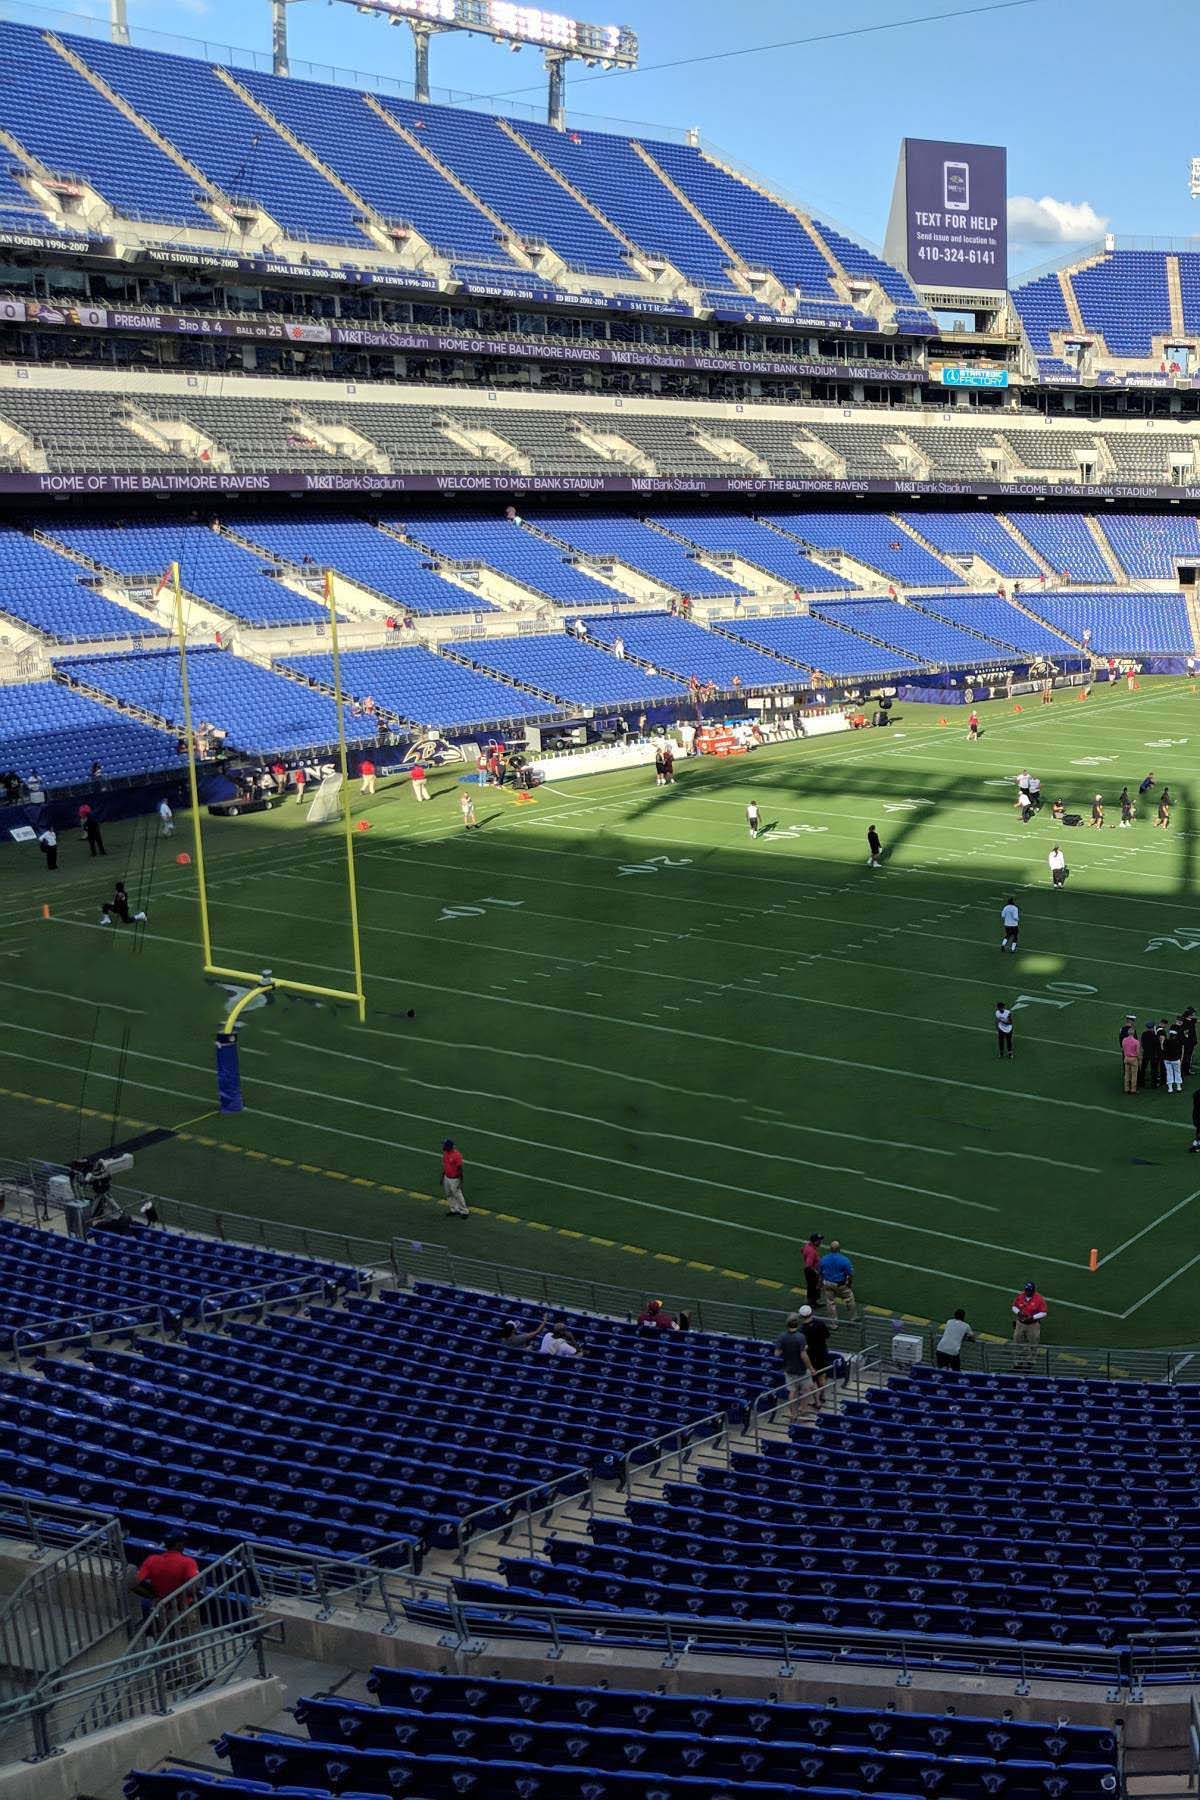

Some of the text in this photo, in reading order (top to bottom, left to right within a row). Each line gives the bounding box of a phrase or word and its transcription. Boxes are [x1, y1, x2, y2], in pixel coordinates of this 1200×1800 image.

[915, 211, 998, 231] TEXT FOR HELP
[15, 237, 44, 249] OGDEN
[47, 241, 89, 253] 1996-2007
[917, 231, 997, 246] Send issue and location to:
[151, 251, 239, 269] MATT STOVER 1996-2008
[918, 246, 995, 265] 410-324-6141
[266, 264, 347, 280] JAMAL LEWIS 2000-2006
[372, 274, 384, 283] RAY
[385, 277, 403, 287] LEWIS
[469, 285, 485, 294] TODD
[5, 304, 16, 318] 0
[630, 302, 660, 313] SMYTH
[88, 311, 99, 325] 0
[114, 314, 282, 337] PREGAME 3RD & 4 BALL ON 25
[338, 329, 364, 344] M&T
[364, 331, 388, 346] Bank
[389, 334, 428, 349] Stadium
[439, 338, 600, 361] HOME OF THE BALTIMORE RAVENS
[611, 351, 685, 368] M&T Bank Stadium
[695, 357, 837, 376] WELCOME TO M&T BANK STADIUM
[849, 366, 924, 382] M&T Bank Stadium
[960, 377, 1003, 385] FACTORY
[40, 475, 270, 489] HOME OF THE BALTIMORE RAVENS
[306, 475, 405, 490] M&T Bank Stadium
[437, 476, 604, 489] WELCOME TO M&T BANK STADIUM
[631, 478, 706, 490] M&T Bank Stadium
[728, 480, 869, 491] HOME OF THE BALTIMORE RAVENS
[895, 482, 972, 493] M&T Bank Stadium
[1000, 484, 1158, 497] WELCOME TO M&T BANK STADIUM
